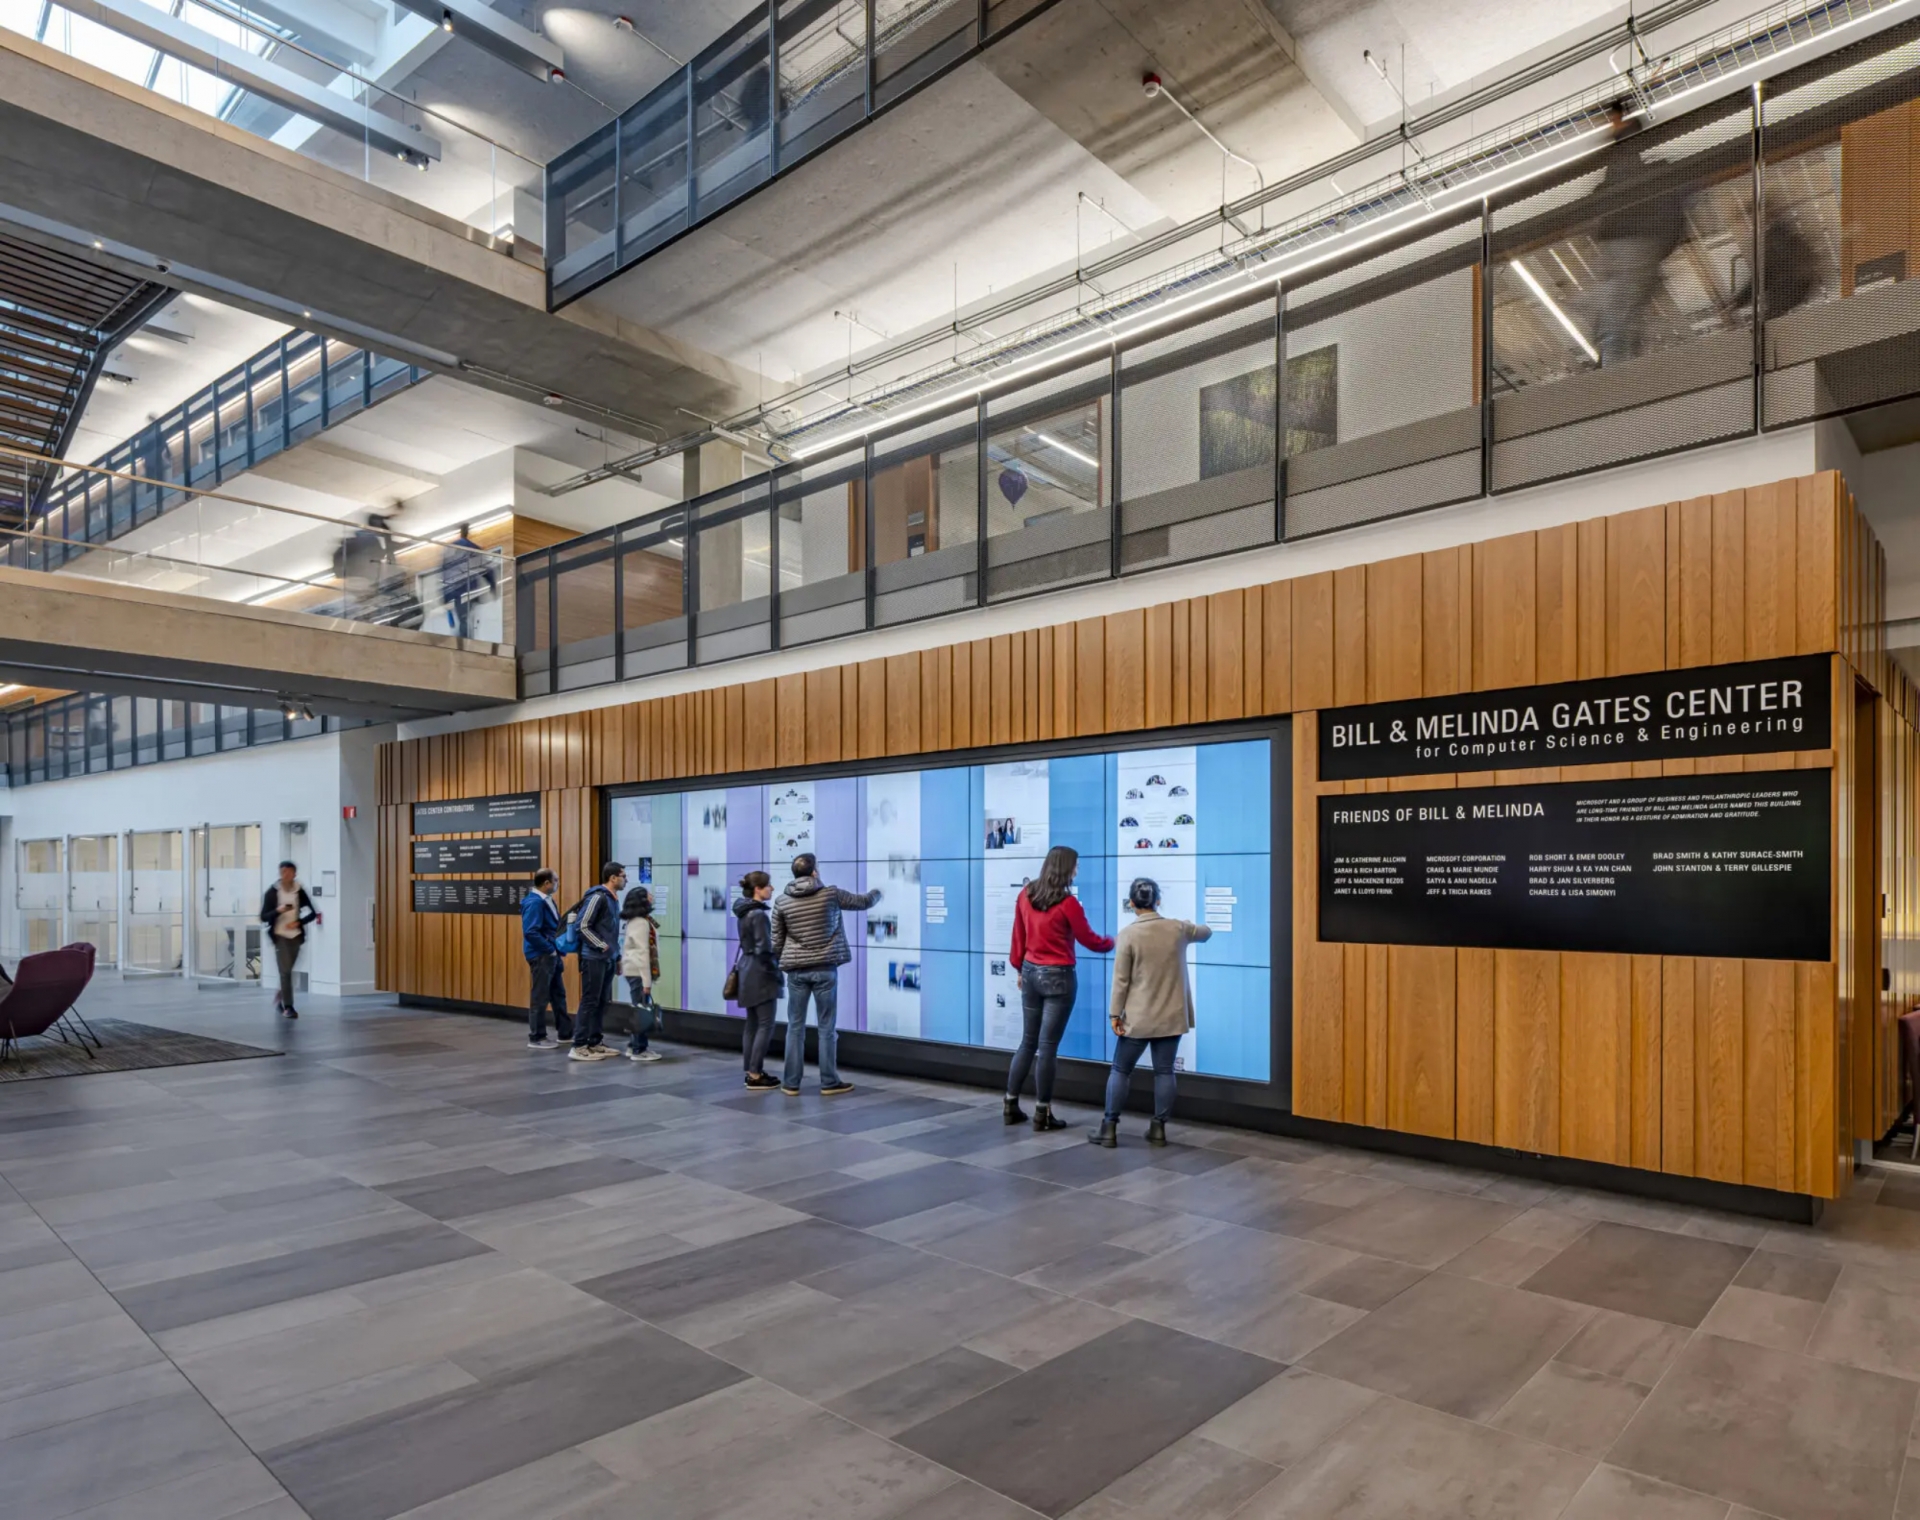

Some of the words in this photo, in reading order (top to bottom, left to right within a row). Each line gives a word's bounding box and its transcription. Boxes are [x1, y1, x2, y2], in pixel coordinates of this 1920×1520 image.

[1332, 722, 1380, 747] BILL
[1390, 720, 1407, 743] &
[1416, 706, 1538, 740] MELINDA
[1552, 695, 1650, 728] GATES
[1666, 680, 1801, 718] CENTER
[1416, 746, 1440, 758] for
[1449, 738, 1537, 756] Computer
[1546, 731, 1625, 748] Science
[1638, 727, 1649, 742] &
[1661, 716, 1803, 741] Engineering
[1334, 809, 1389, 824] FRIENDS
[1396, 808, 1412, 821] OF
[1419, 807, 1448, 821] BILL
[1456, 806, 1465, 819] &
[1473, 802, 1544, 818] MELINDA
[1740, 850, 1802, 859] SURACE-SMITH
